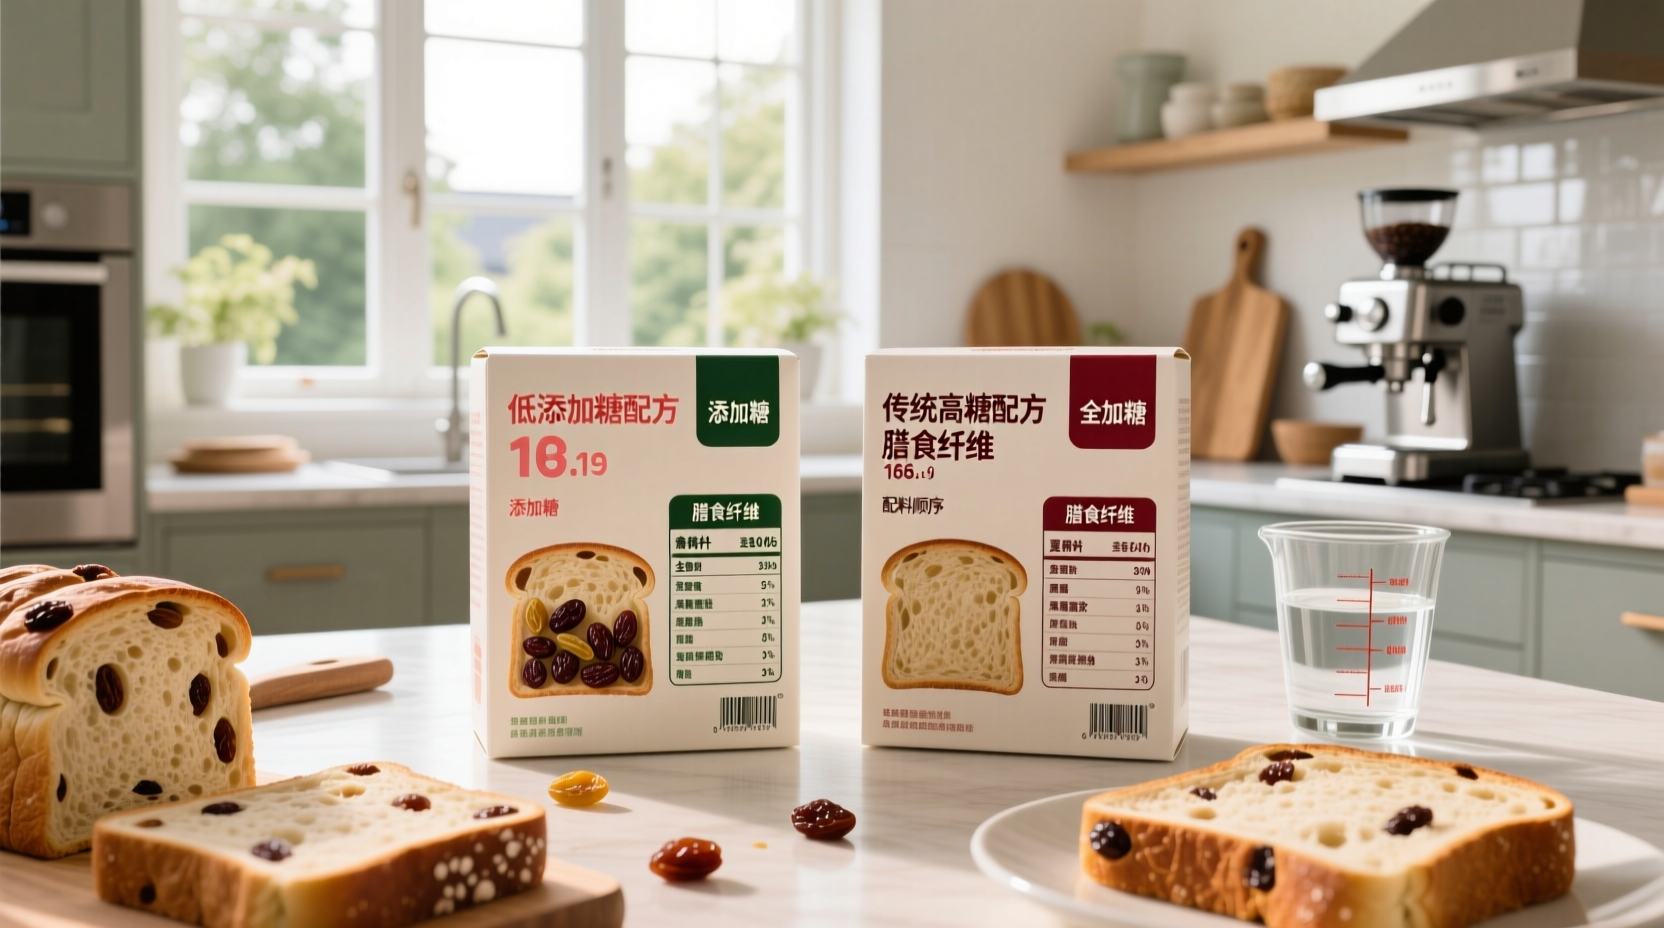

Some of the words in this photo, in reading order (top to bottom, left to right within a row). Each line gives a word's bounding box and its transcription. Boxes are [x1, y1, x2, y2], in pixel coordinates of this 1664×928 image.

[507, 392, 679, 425] 低添加糖配方
[708, 399, 770, 425] 添加糖
[882, 392, 1047, 425] 传统高糖配方
[1079, 398, 1147, 426] 全加糖
[509, 497, 559, 518] 添加糖
[882, 495, 944, 515] 配料顺序
